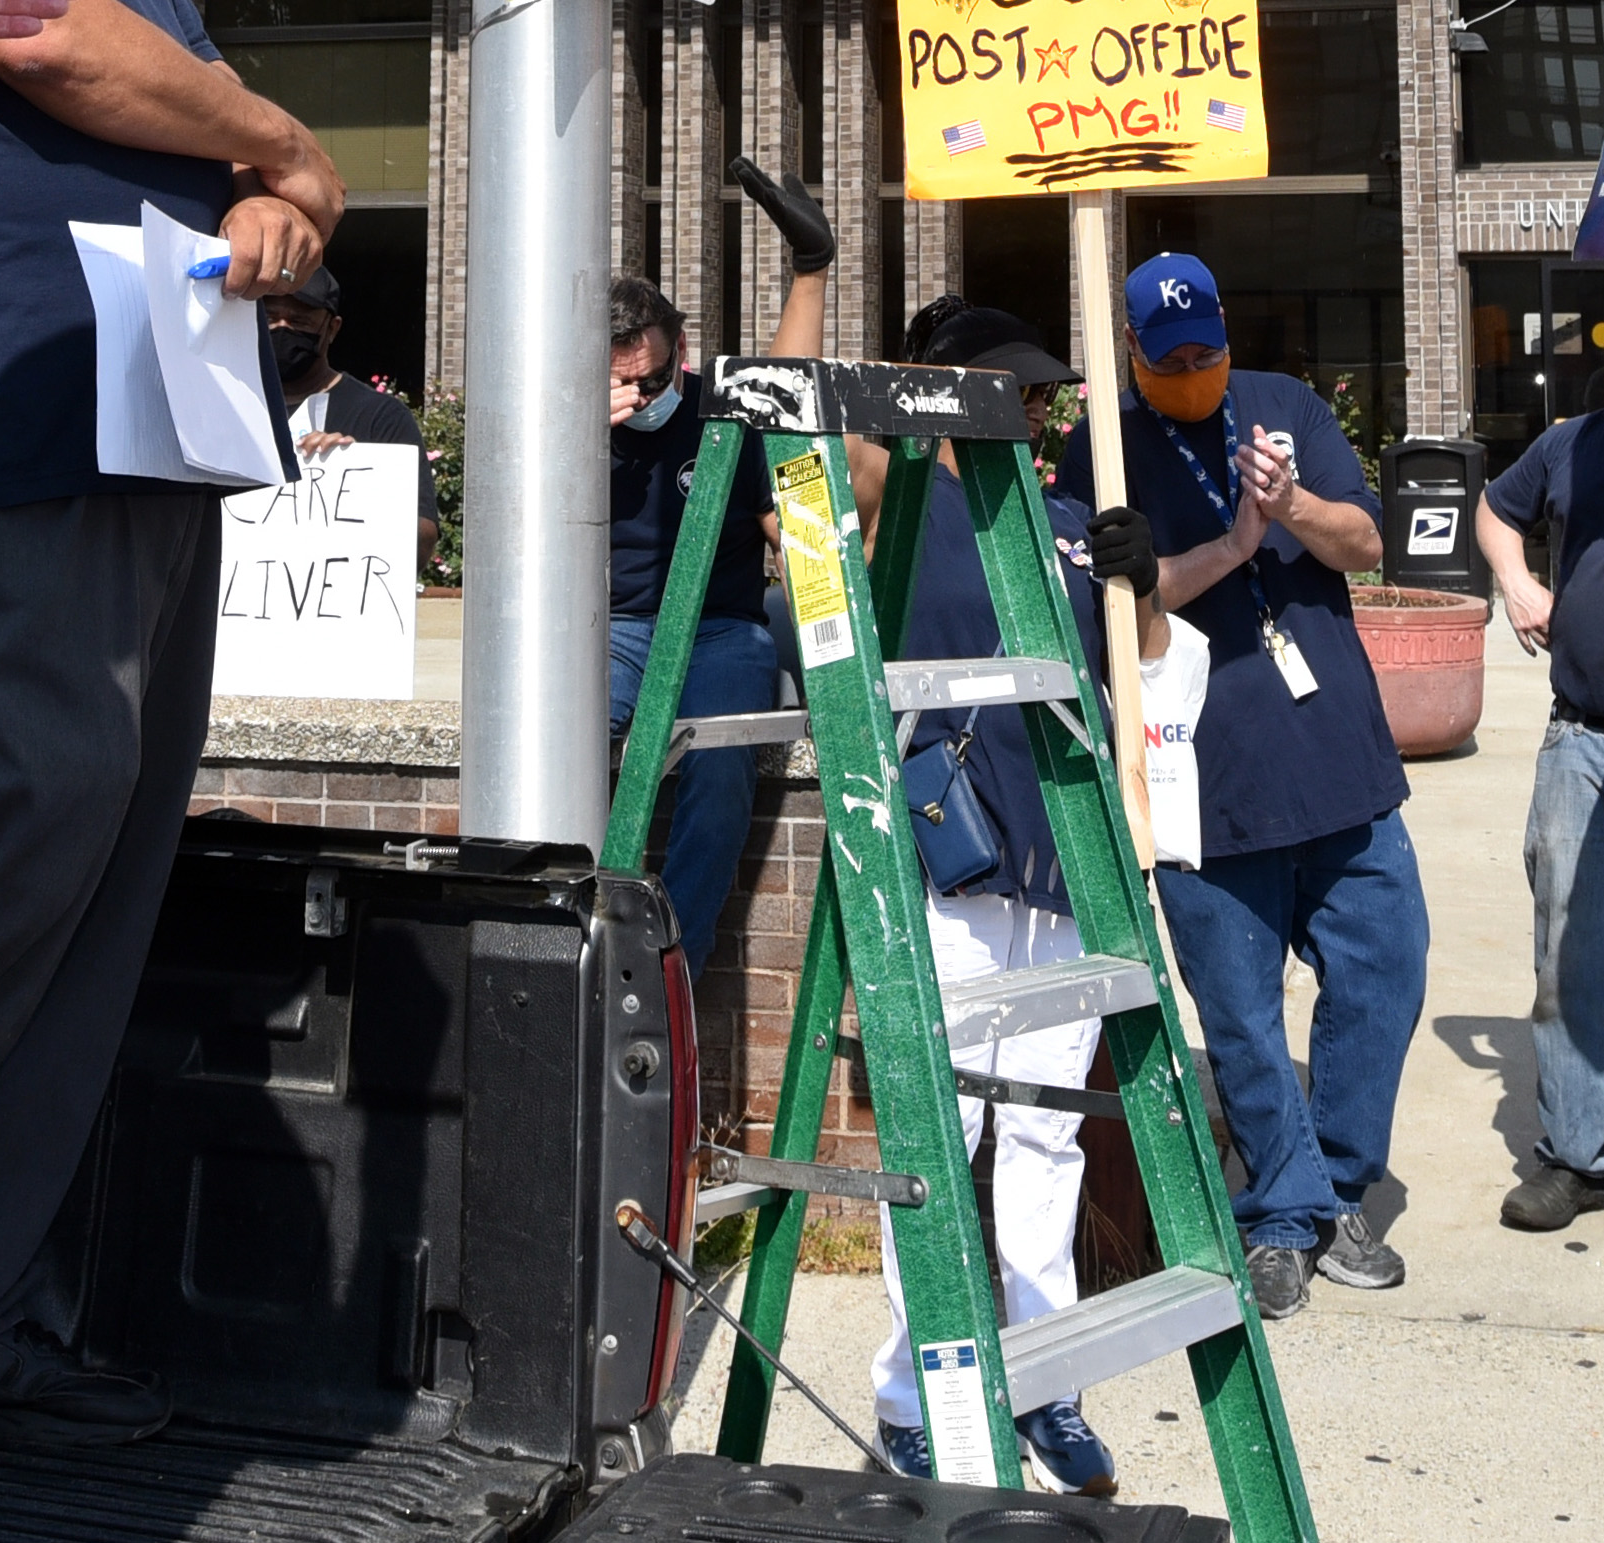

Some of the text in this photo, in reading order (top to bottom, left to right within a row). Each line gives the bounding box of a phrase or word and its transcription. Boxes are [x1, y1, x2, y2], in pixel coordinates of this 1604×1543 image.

[909, 14, 1253, 90] POST OFFICE
[1027, 89, 1180, 154] PMG!!
[1159, 278, 1192, 310] KC
[914, 394, 961, 415] HUSKY
[784, 456, 816, 476] CAUTION
